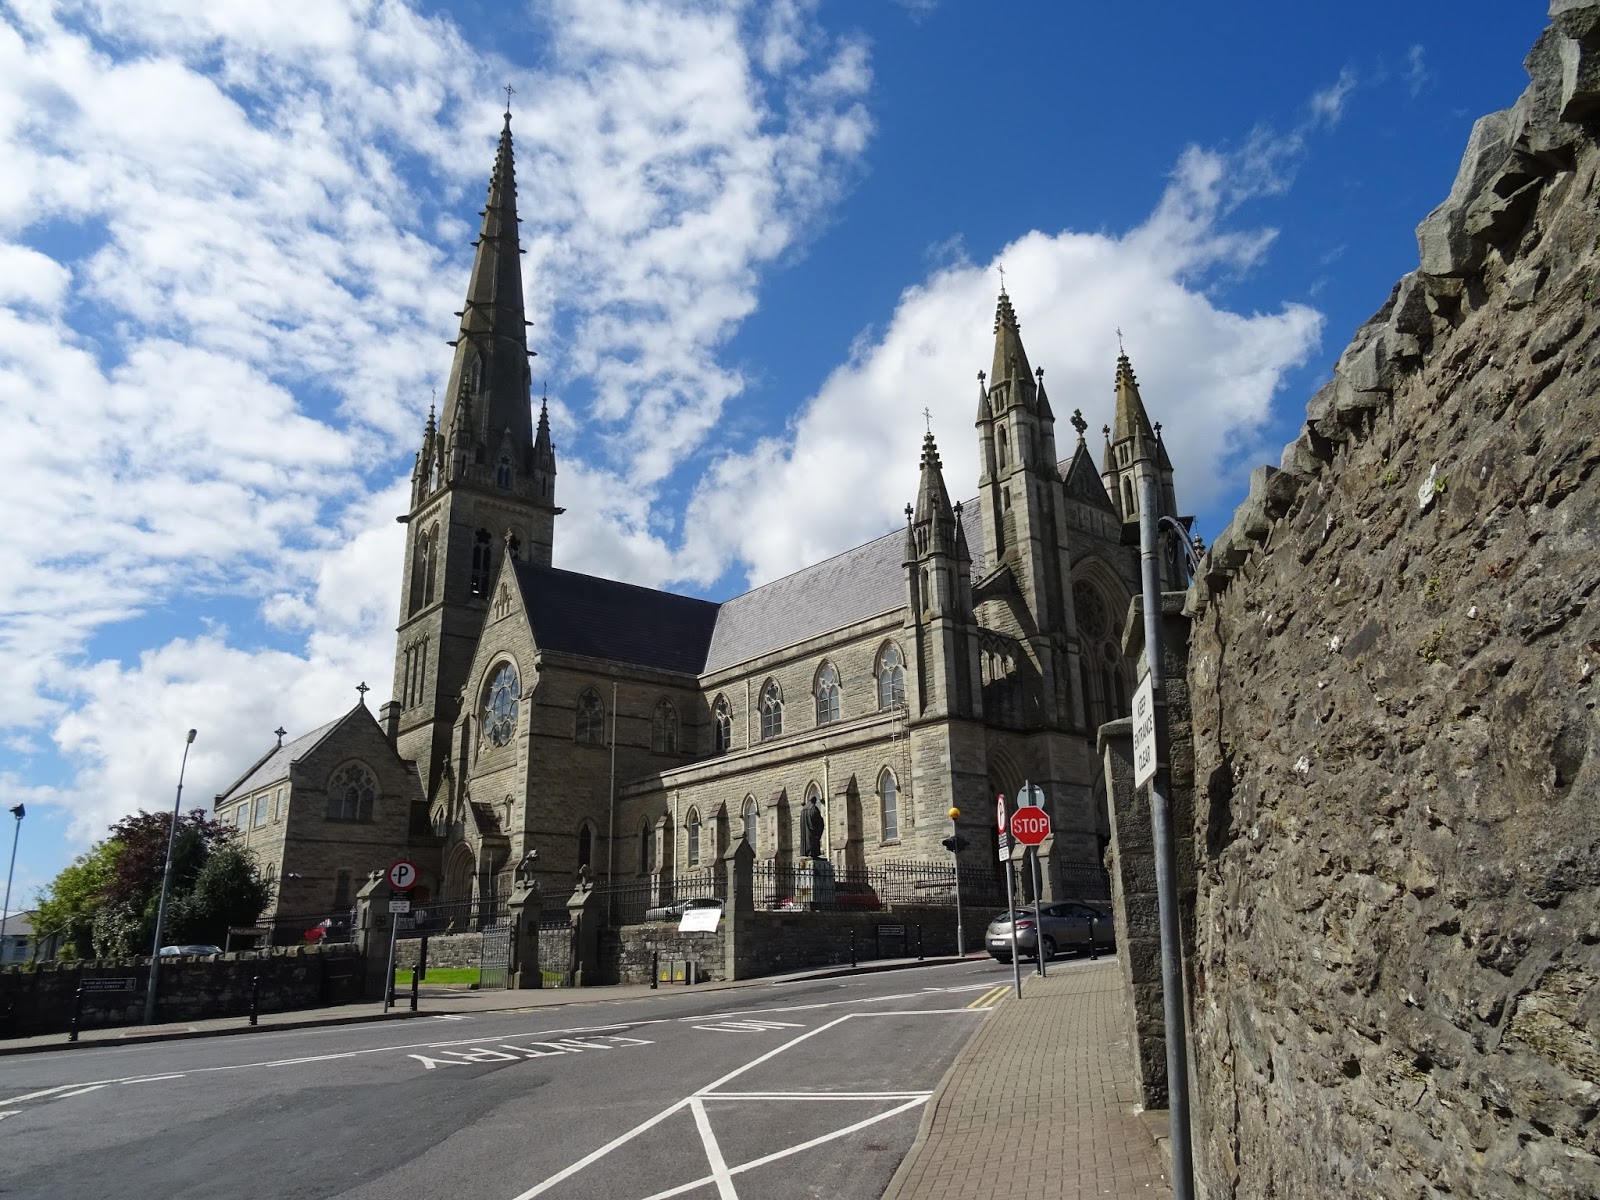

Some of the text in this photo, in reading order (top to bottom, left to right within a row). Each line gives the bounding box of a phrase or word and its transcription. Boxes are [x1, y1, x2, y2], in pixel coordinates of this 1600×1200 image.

[1134, 714, 1153, 751] ENTRANCE
[1138, 745, 1151, 772] CLEAR
[1013, 818, 1048, 833] STOP
[398, 866, 409, 884] P
[407, 1019, 806, 1069] NO ENTRY
